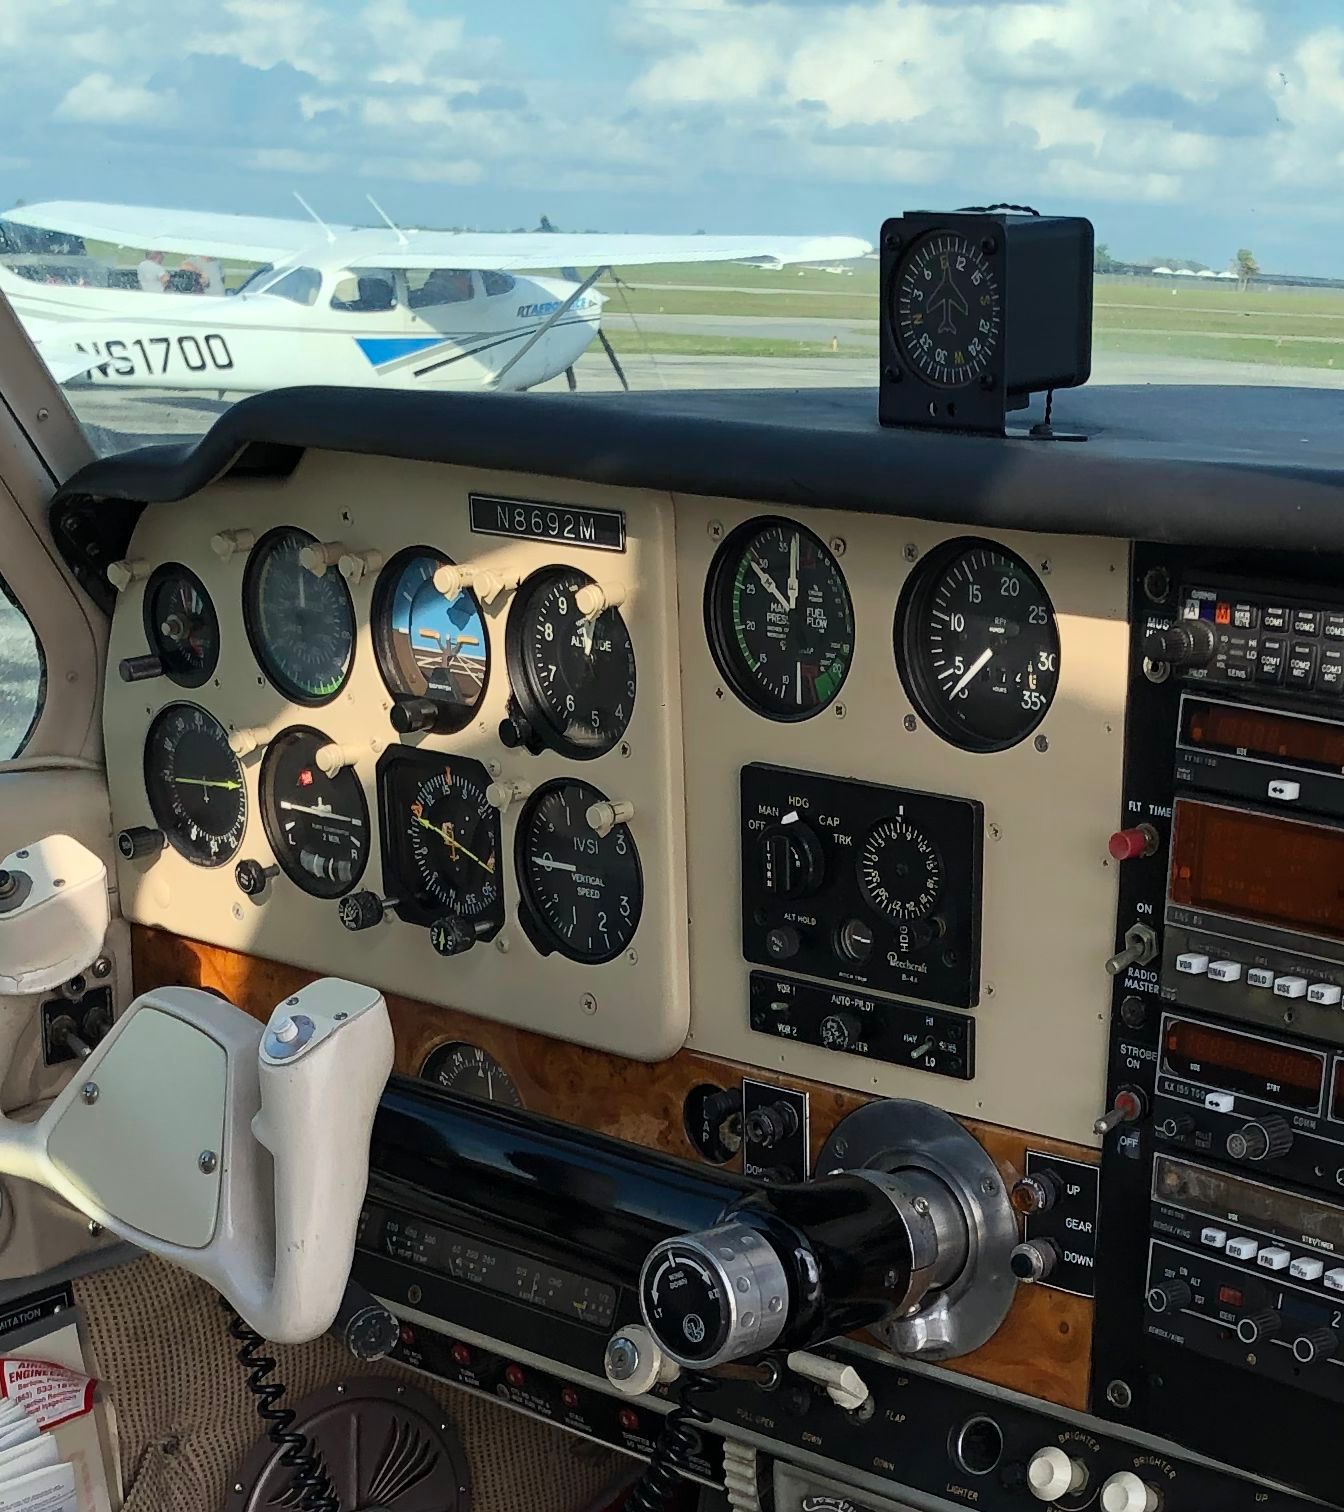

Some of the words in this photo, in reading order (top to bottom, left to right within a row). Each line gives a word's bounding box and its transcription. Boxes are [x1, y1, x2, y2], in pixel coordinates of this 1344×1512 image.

[956, 256, 966, 271] 12
[971, 271, 983, 285] 15
[979, 319, 990, 332] 21
[920, 333, 933, 351] 33
[968, 338, 981, 357] 24
[935, 348, 948, 364] 30
[497, 506, 596, 540] N8692M
[778, 541, 788, 552] 35
[746, 583, 756, 594] 25
[968, 585, 982, 603] 15
[1000, 577, 1020, 597] 20
[807, 608, 826, 618] FUEL
[1029, 605, 1047, 624] 25
[746, 621, 756, 631] 20
[807, 618, 827, 629] FLOW
[951, 613, 964, 631] 10
[1264, 616, 1283, 627] COM1
[1295, 621, 1314, 632] COM2
[544, 622, 554, 641] 8
[570, 634, 612, 652] ALTUDE
[1038, 651, 1056, 671] 30
[1261, 656, 1280, 666] COM1
[1291, 659, 1311, 670] COM2
[548, 666, 556, 682] 7
[1264, 665, 1276, 674] MIC
[1292, 668, 1306, 678] MIC
[1321, 664, 1342, 675] COM3
[1324, 673, 1337, 682] MIC
[566, 694, 575, 712] 6
[1021, 691, 1040, 710] 35
[788, 795, 810, 808] HDG
[1129, 800, 1142, 812] FLT
[1149, 804, 1172, 817] TIME
[759, 805, 779, 817] MAN
[748, 820, 765, 830] OFF
[819, 815, 840, 827] CAP
[574, 837, 599, 854] IVSI
[833, 834, 852, 846] TRK
[572, 873, 605, 888] VERTICAL
[578, 888, 600, 898] SPEED
[1137, 903, 1152, 914] ON
[784, 912, 796, 921] ALT
[798, 914, 817, 926] HOLD
[1128, 967, 1157, 982] RADIO
[1248, 973, 1266, 984] HOLD
[1124, 978, 1160, 994] MASTER
[831, 994, 875, 1012] AUTO-PILOT
[1120, 1043, 1158, 1062] STROBE
[1126, 1058, 1140, 1070] ON
[1120, 1136, 1138, 1147] OFF
[1066, 1184, 1080, 1195] UP
[1066, 1218, 1092, 1233] GEAR
[1064, 1251, 1093, 1267] DOWN
[1191, 1277, 1201, 1286] ALT
[885, 1409, 906, 1423] FLAP
[1057, 1432, 1101, 1453] BRIGHTER
[873, 1457, 895, 1471] DOWN
[1133, 1456, 1176, 1480] BRIGHTER
[947, 1483, 979, 1501] LIGHTER
